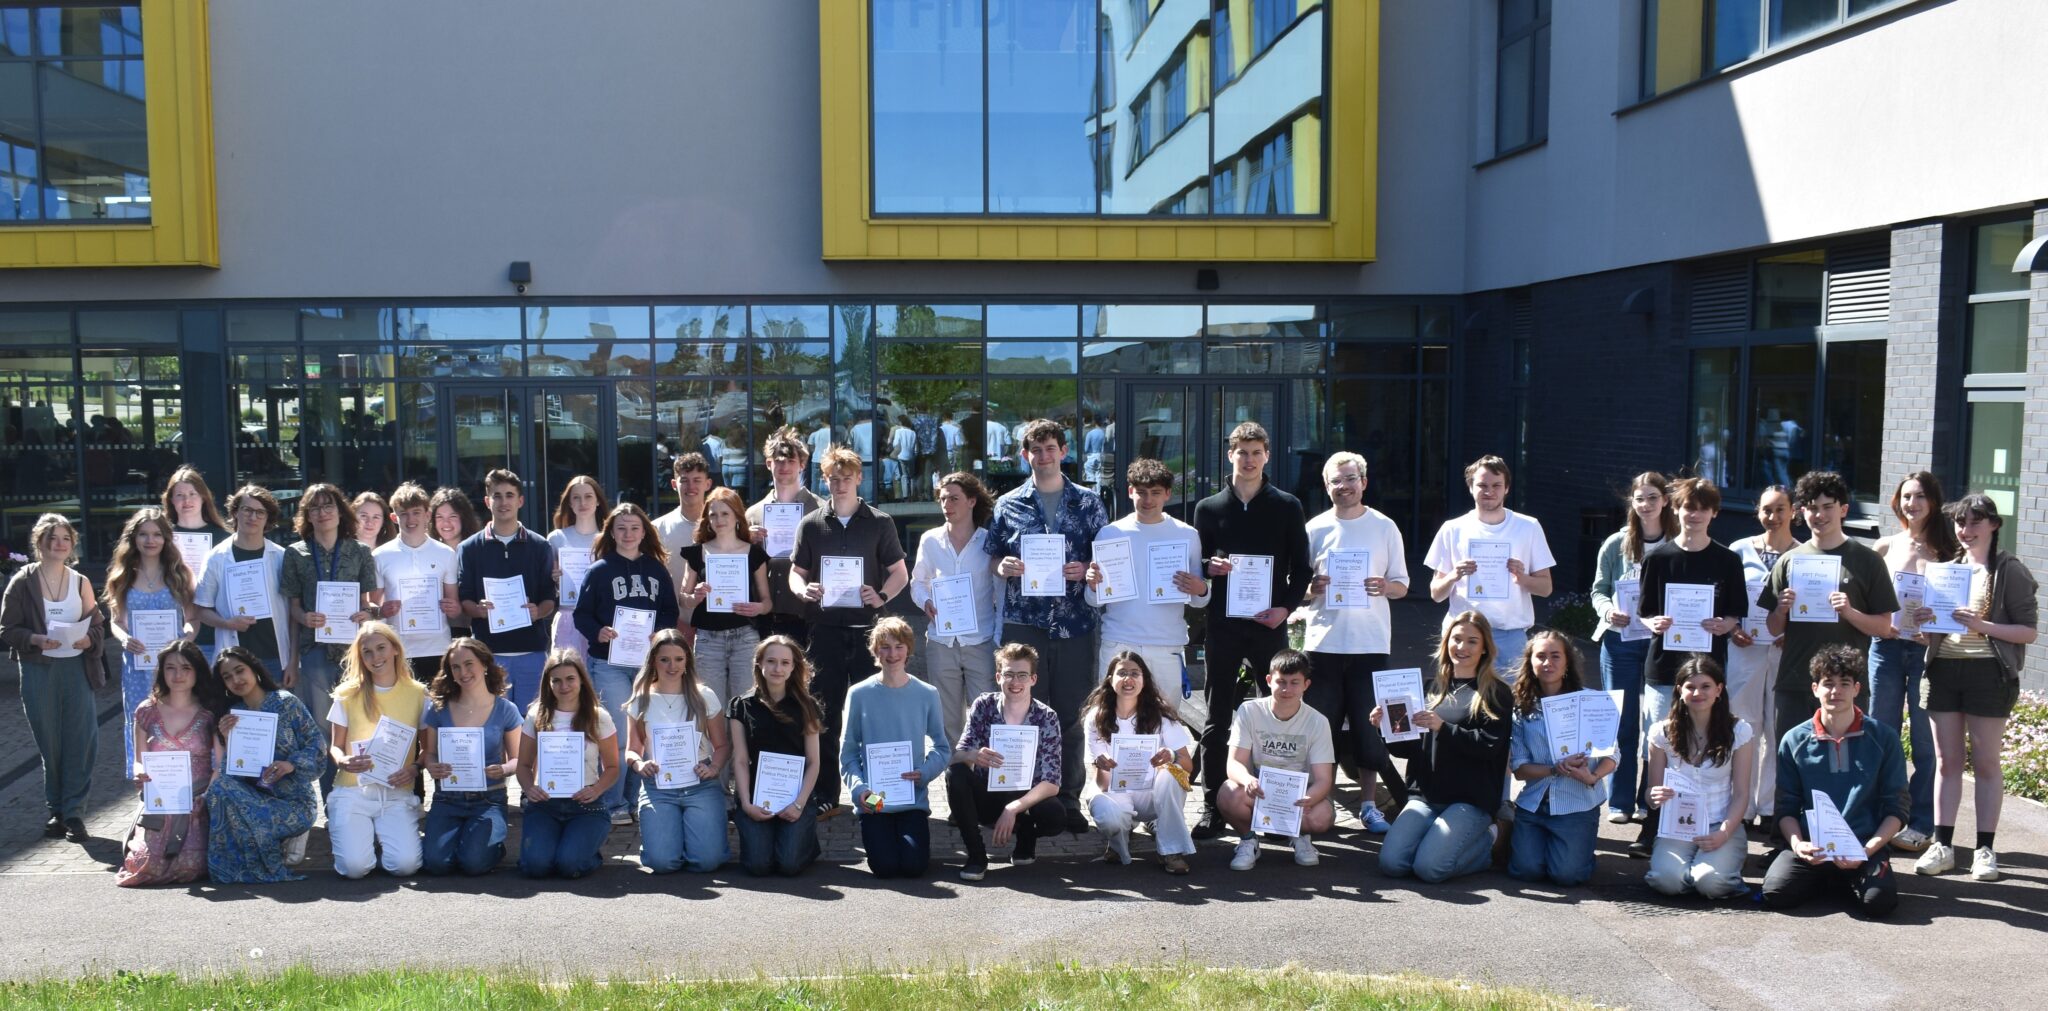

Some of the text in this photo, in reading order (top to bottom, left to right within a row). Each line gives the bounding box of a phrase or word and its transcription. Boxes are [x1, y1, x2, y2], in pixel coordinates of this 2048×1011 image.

[612, 574, 660, 602] GAP
[1262, 740, 1297, 751] JAPAN
[1266, 778, 1285, 788] Biology
